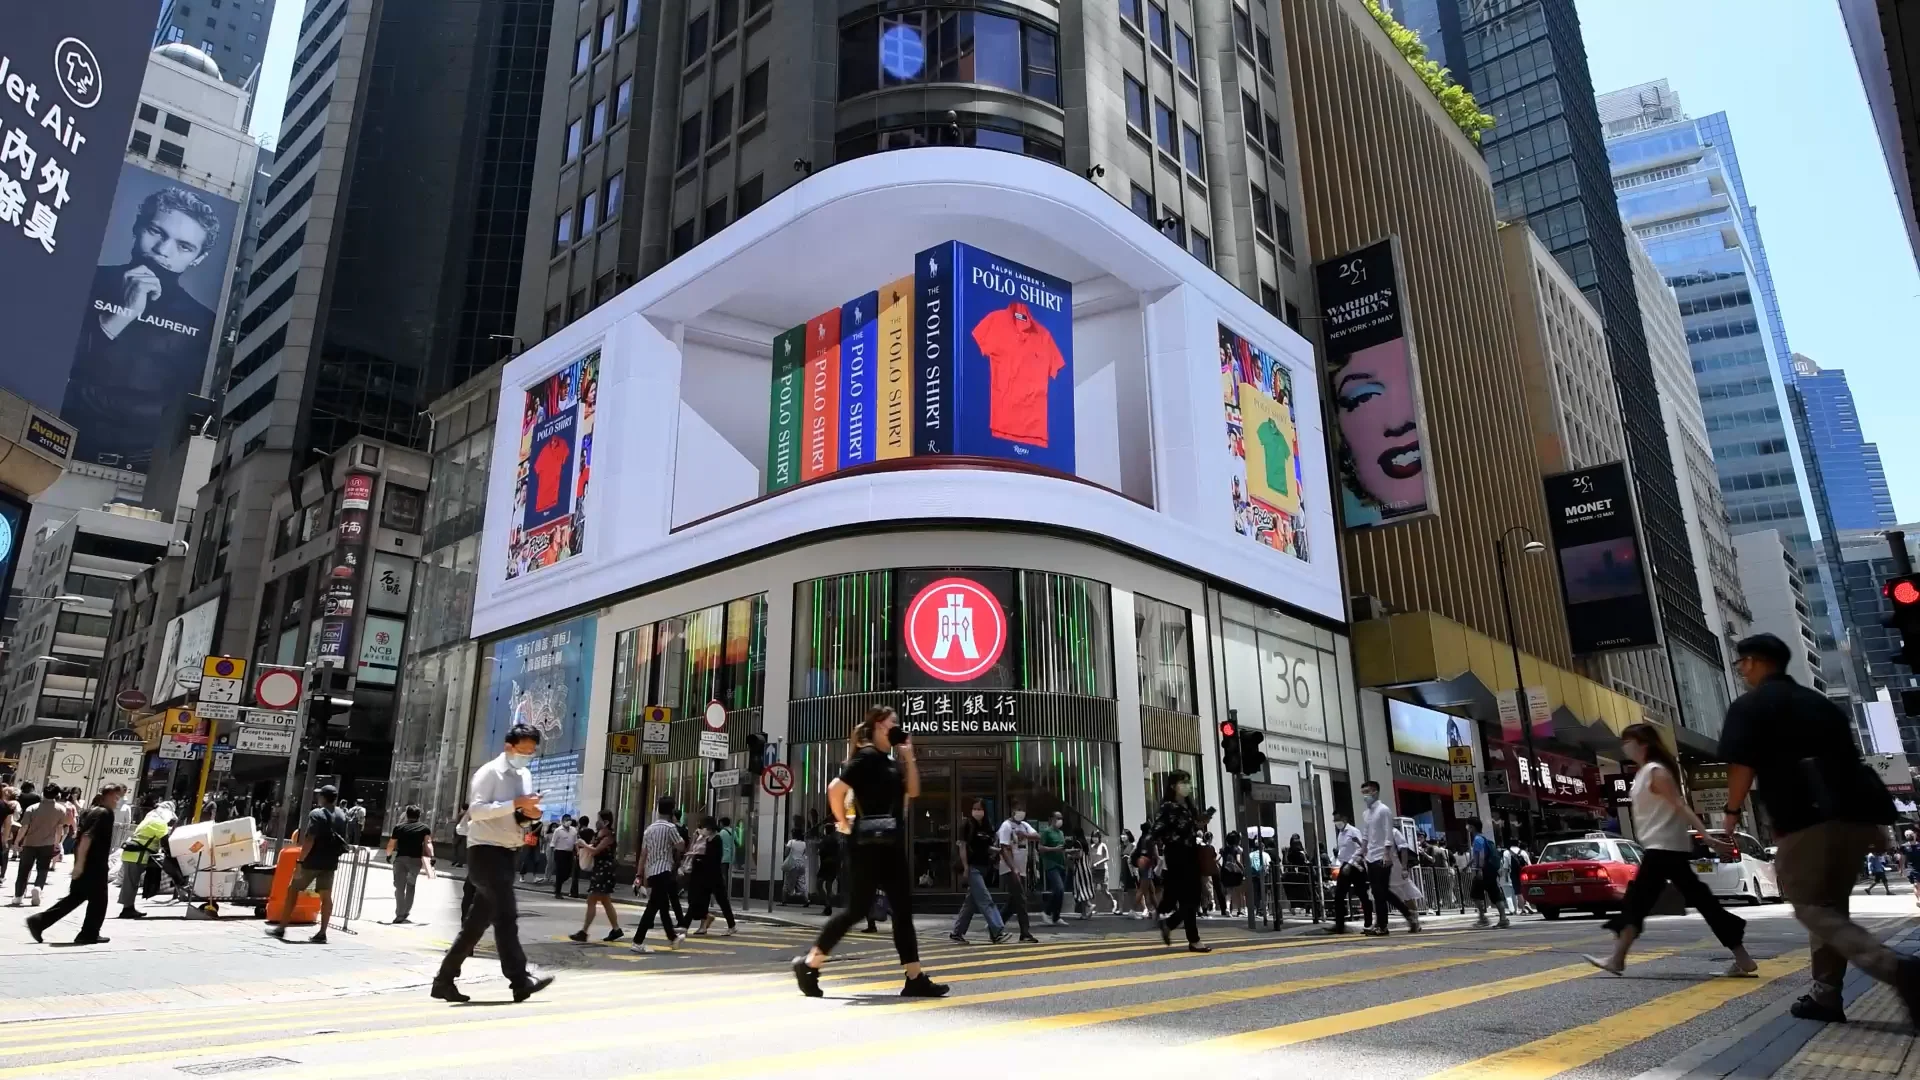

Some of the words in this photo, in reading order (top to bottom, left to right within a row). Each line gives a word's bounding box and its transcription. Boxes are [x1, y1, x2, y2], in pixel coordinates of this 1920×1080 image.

[41, 103, 87, 155] Air
[0, 118, 71, 210] 內外
[972, 266, 1016, 296] POLO
[1020, 283, 1063, 313] SHIRT
[991, 263, 1013, 276] RALPH
[1015, 272, 1046, 288] LAUREN'S
[928, 286, 940, 296] THE
[1327, 287, 1393, 317] WARHOL'S
[93, 299, 134, 320] SAINT
[137, 312, 199, 337] LAURENT
[1332, 299, 1389, 326] MARILYN
[852, 331, 864, 340] THE
[926, 299, 940, 360] POLO
[1330, 330, 1347, 341] NEW
[1348, 323, 1368, 334] YORK
[1378, 313, 1394, 324] MAY
[889, 328, 902, 383] POLO
[850, 343, 864, 397] POLO
[813, 358, 827, 412] POLO
[926, 365, 940, 429] SHIRT
[779, 374, 792, 425] POLO
[537, 425, 554, 442] POLO
[554, 415, 573, 433] SHIRT
[849, 402, 863, 460] SHIRT
[888, 388, 902, 448] SHIRT
[31, 420, 69, 447] Avanti
[811, 415, 825, 473] SHIRT
[776, 429, 790, 485] SHIRT
[1565, 498, 1612, 517] MONET
[321, 643, 340, 653] 8/F
[369, 645, 392, 655] NCB
[228, 680, 235, 688] 7
[1273, 651, 1310, 708] 36
[226, 693, 233, 701] 7
[902, 694, 1017, 716] 恒生銀行
[902, 721, 938, 732] HANG
[942, 721, 979, 732] SENG
[983, 721, 1017, 732] BANK
[183, 751, 193, 759] 12
[103, 767, 136, 775] NIKKEN'S
[1398, 759, 1432, 780] UNDER
